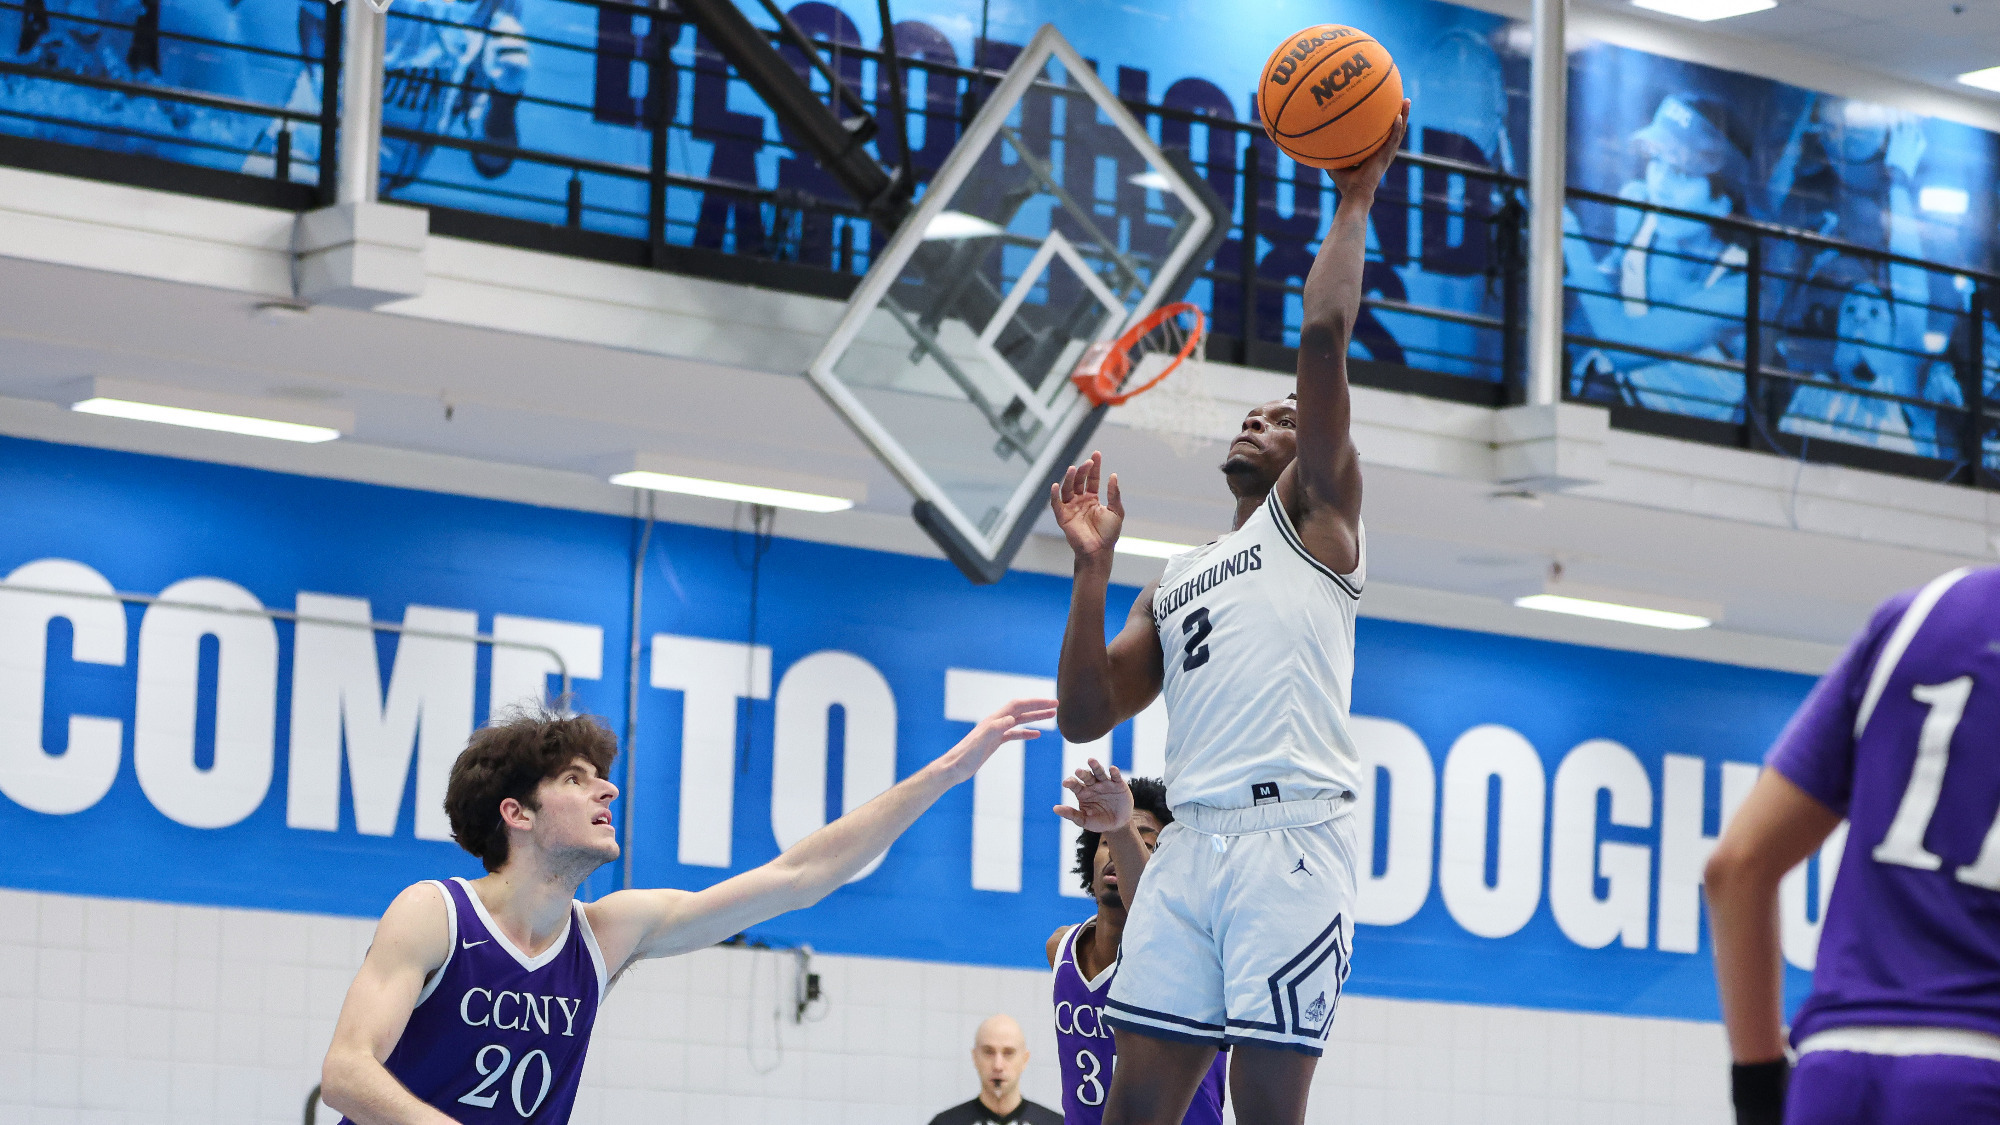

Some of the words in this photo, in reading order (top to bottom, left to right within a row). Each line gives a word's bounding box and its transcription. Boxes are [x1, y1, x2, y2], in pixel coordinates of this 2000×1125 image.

[1270, 28, 1356, 86] Wilson
[1310, 52, 1372, 107] NCAA
[1155, 544, 1262, 628] OODHOUNDS
[1182, 606, 1213, 673] 2
[650, 633, 898, 883] TO
[1260, 786, 1271, 796] M
[460, 987, 582, 1037] CCNY
[457, 1044, 552, 1118] 20
[1075, 1049, 1118, 1106] 3
